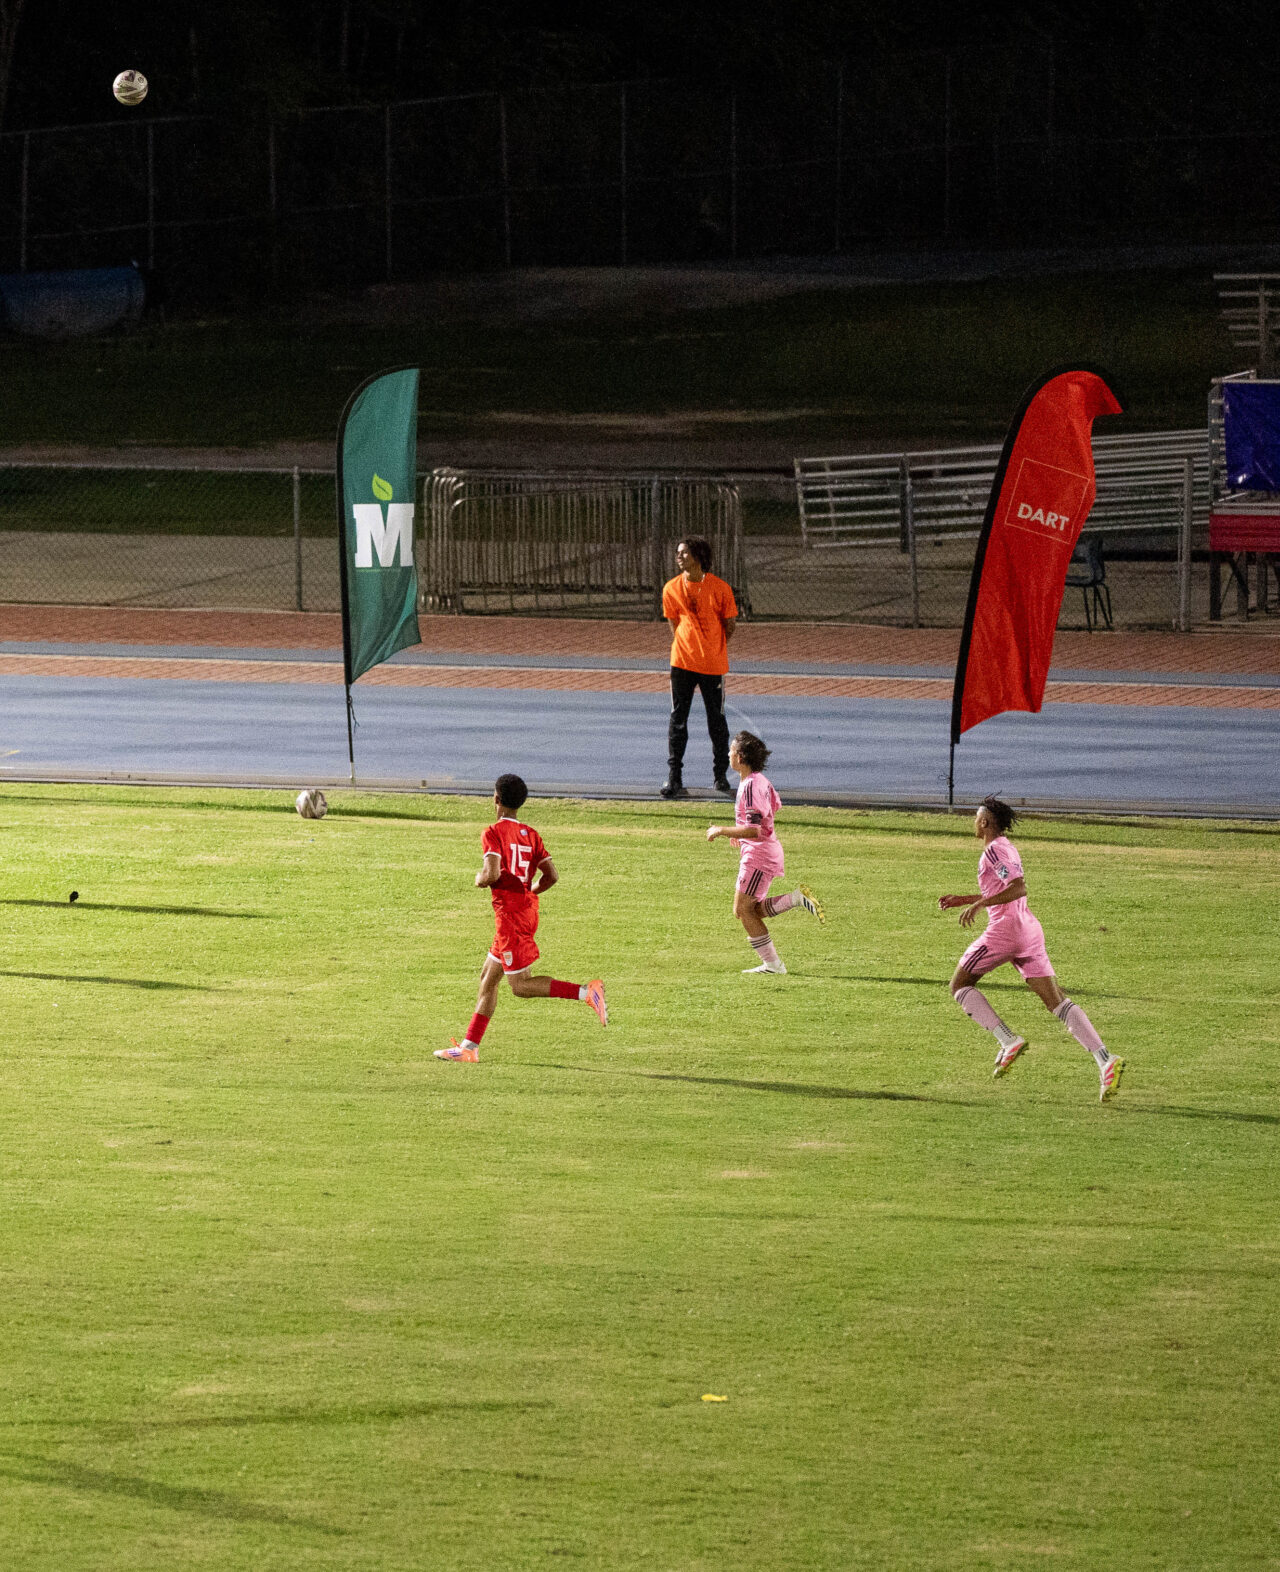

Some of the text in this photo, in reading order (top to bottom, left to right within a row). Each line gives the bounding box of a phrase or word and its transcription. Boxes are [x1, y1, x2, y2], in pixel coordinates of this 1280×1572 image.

[353, 503, 414, 568] M
[1017, 503, 1070, 531] DART
[510, 843, 532, 884] 15
